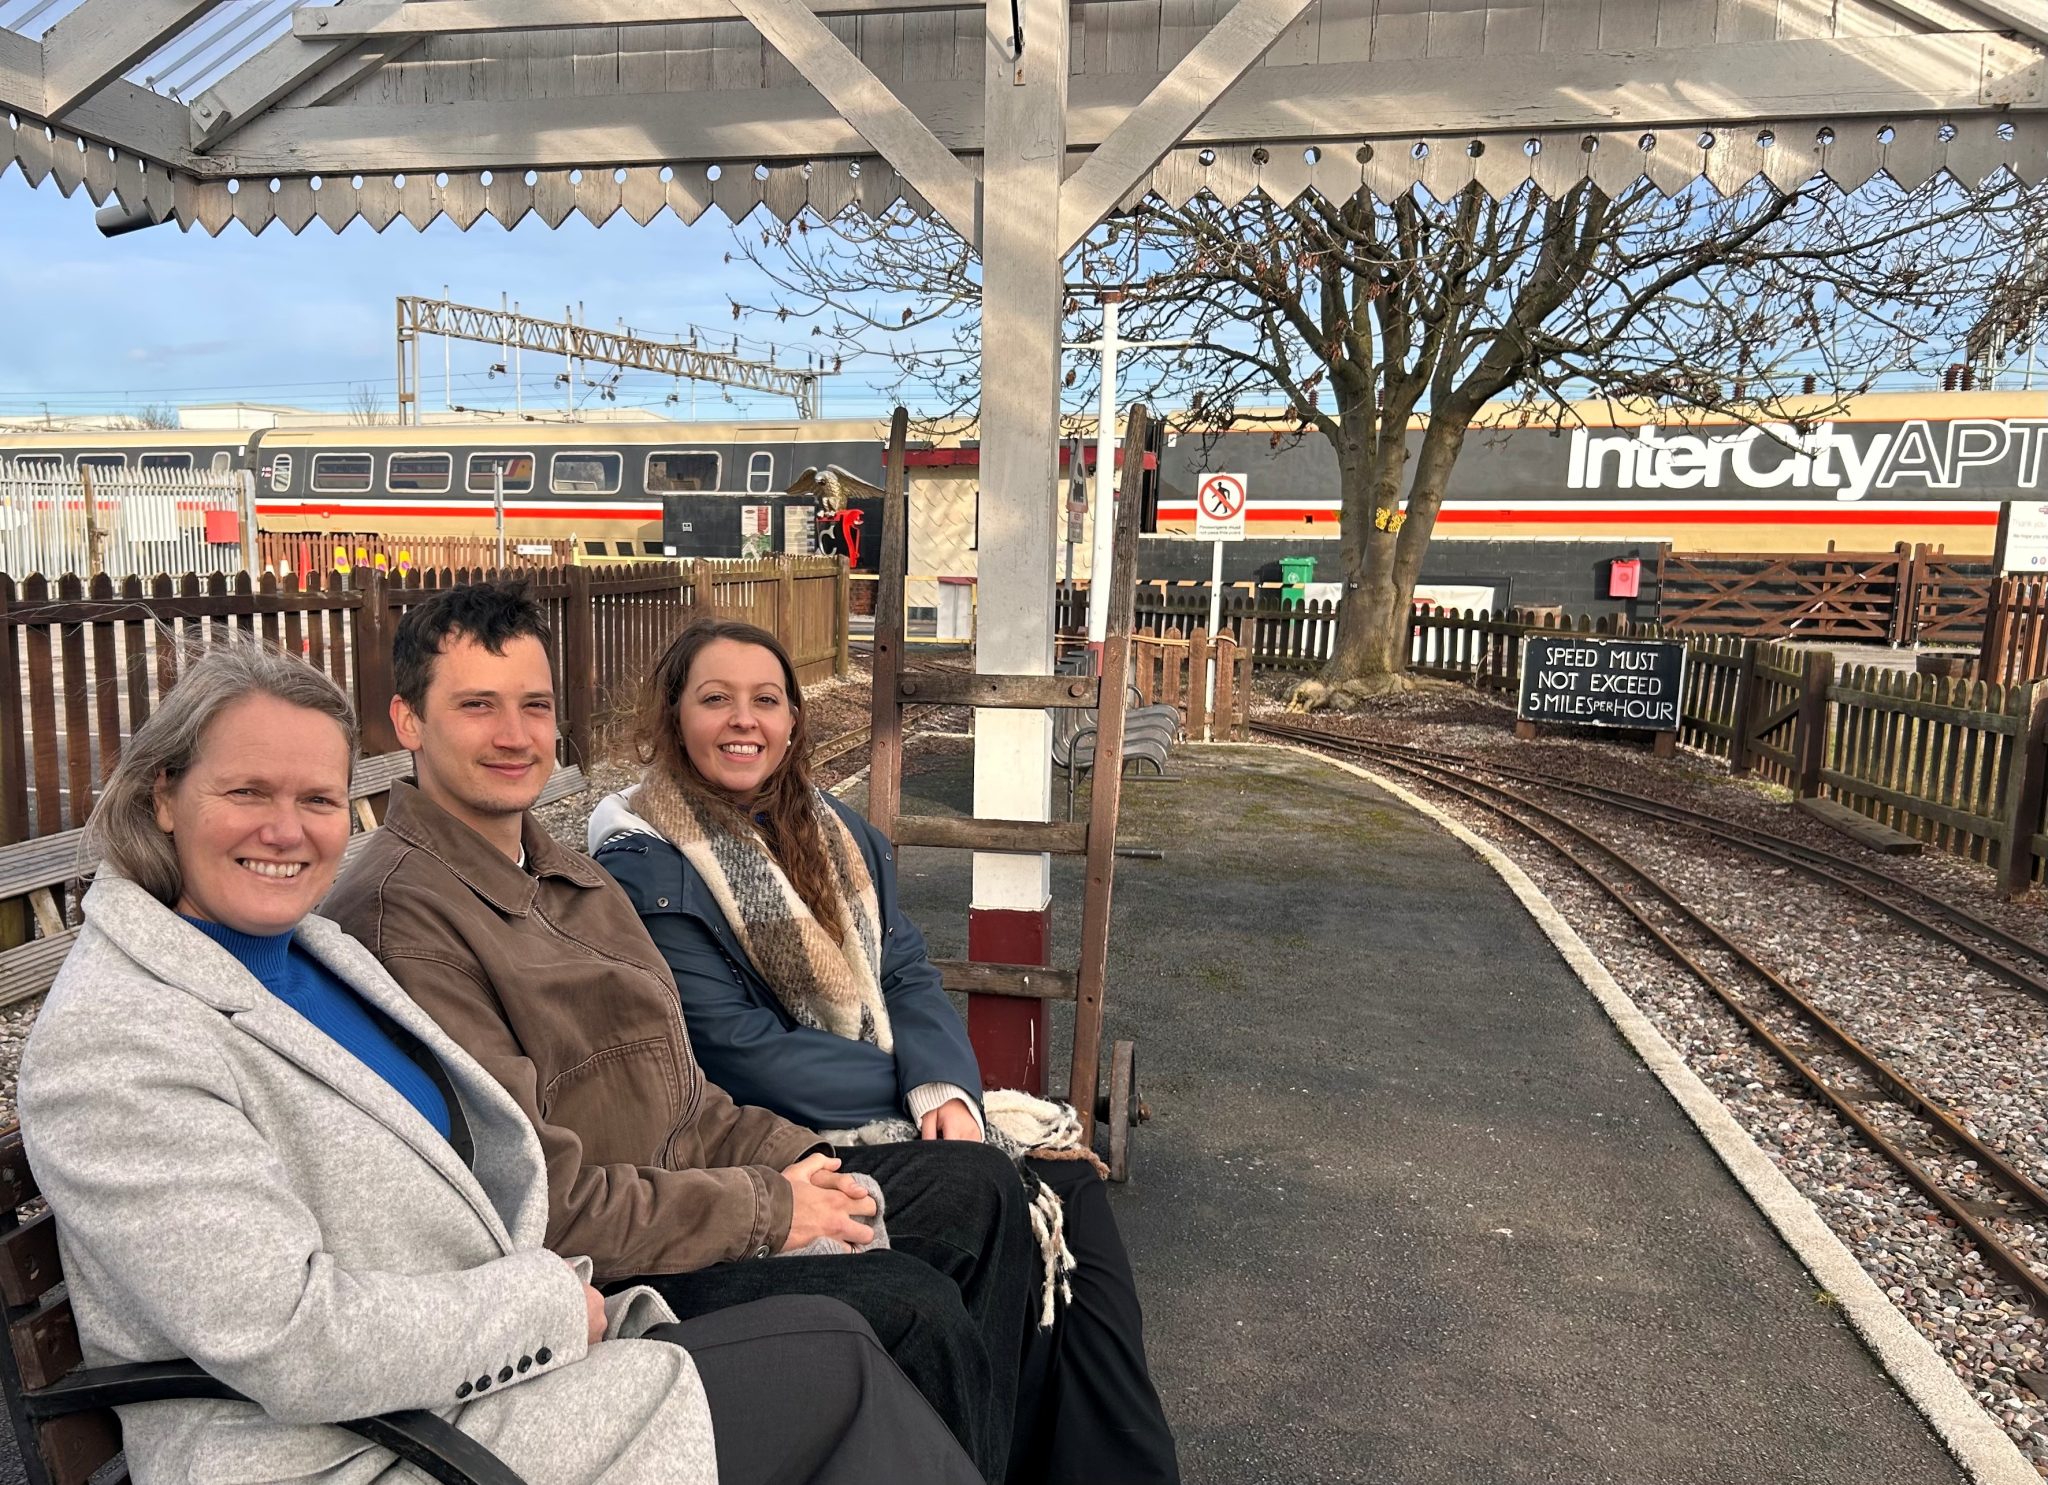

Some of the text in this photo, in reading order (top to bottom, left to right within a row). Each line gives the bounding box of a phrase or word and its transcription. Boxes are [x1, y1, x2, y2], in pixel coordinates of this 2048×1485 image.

[1567, 421, 1891, 501] InterCity
[1546, 647, 1659, 671] SPEED MUST
[1538, 671, 1661, 696] NOT EXCEED
[1529, 693, 1674, 720] 5 MILES PER HOUR
